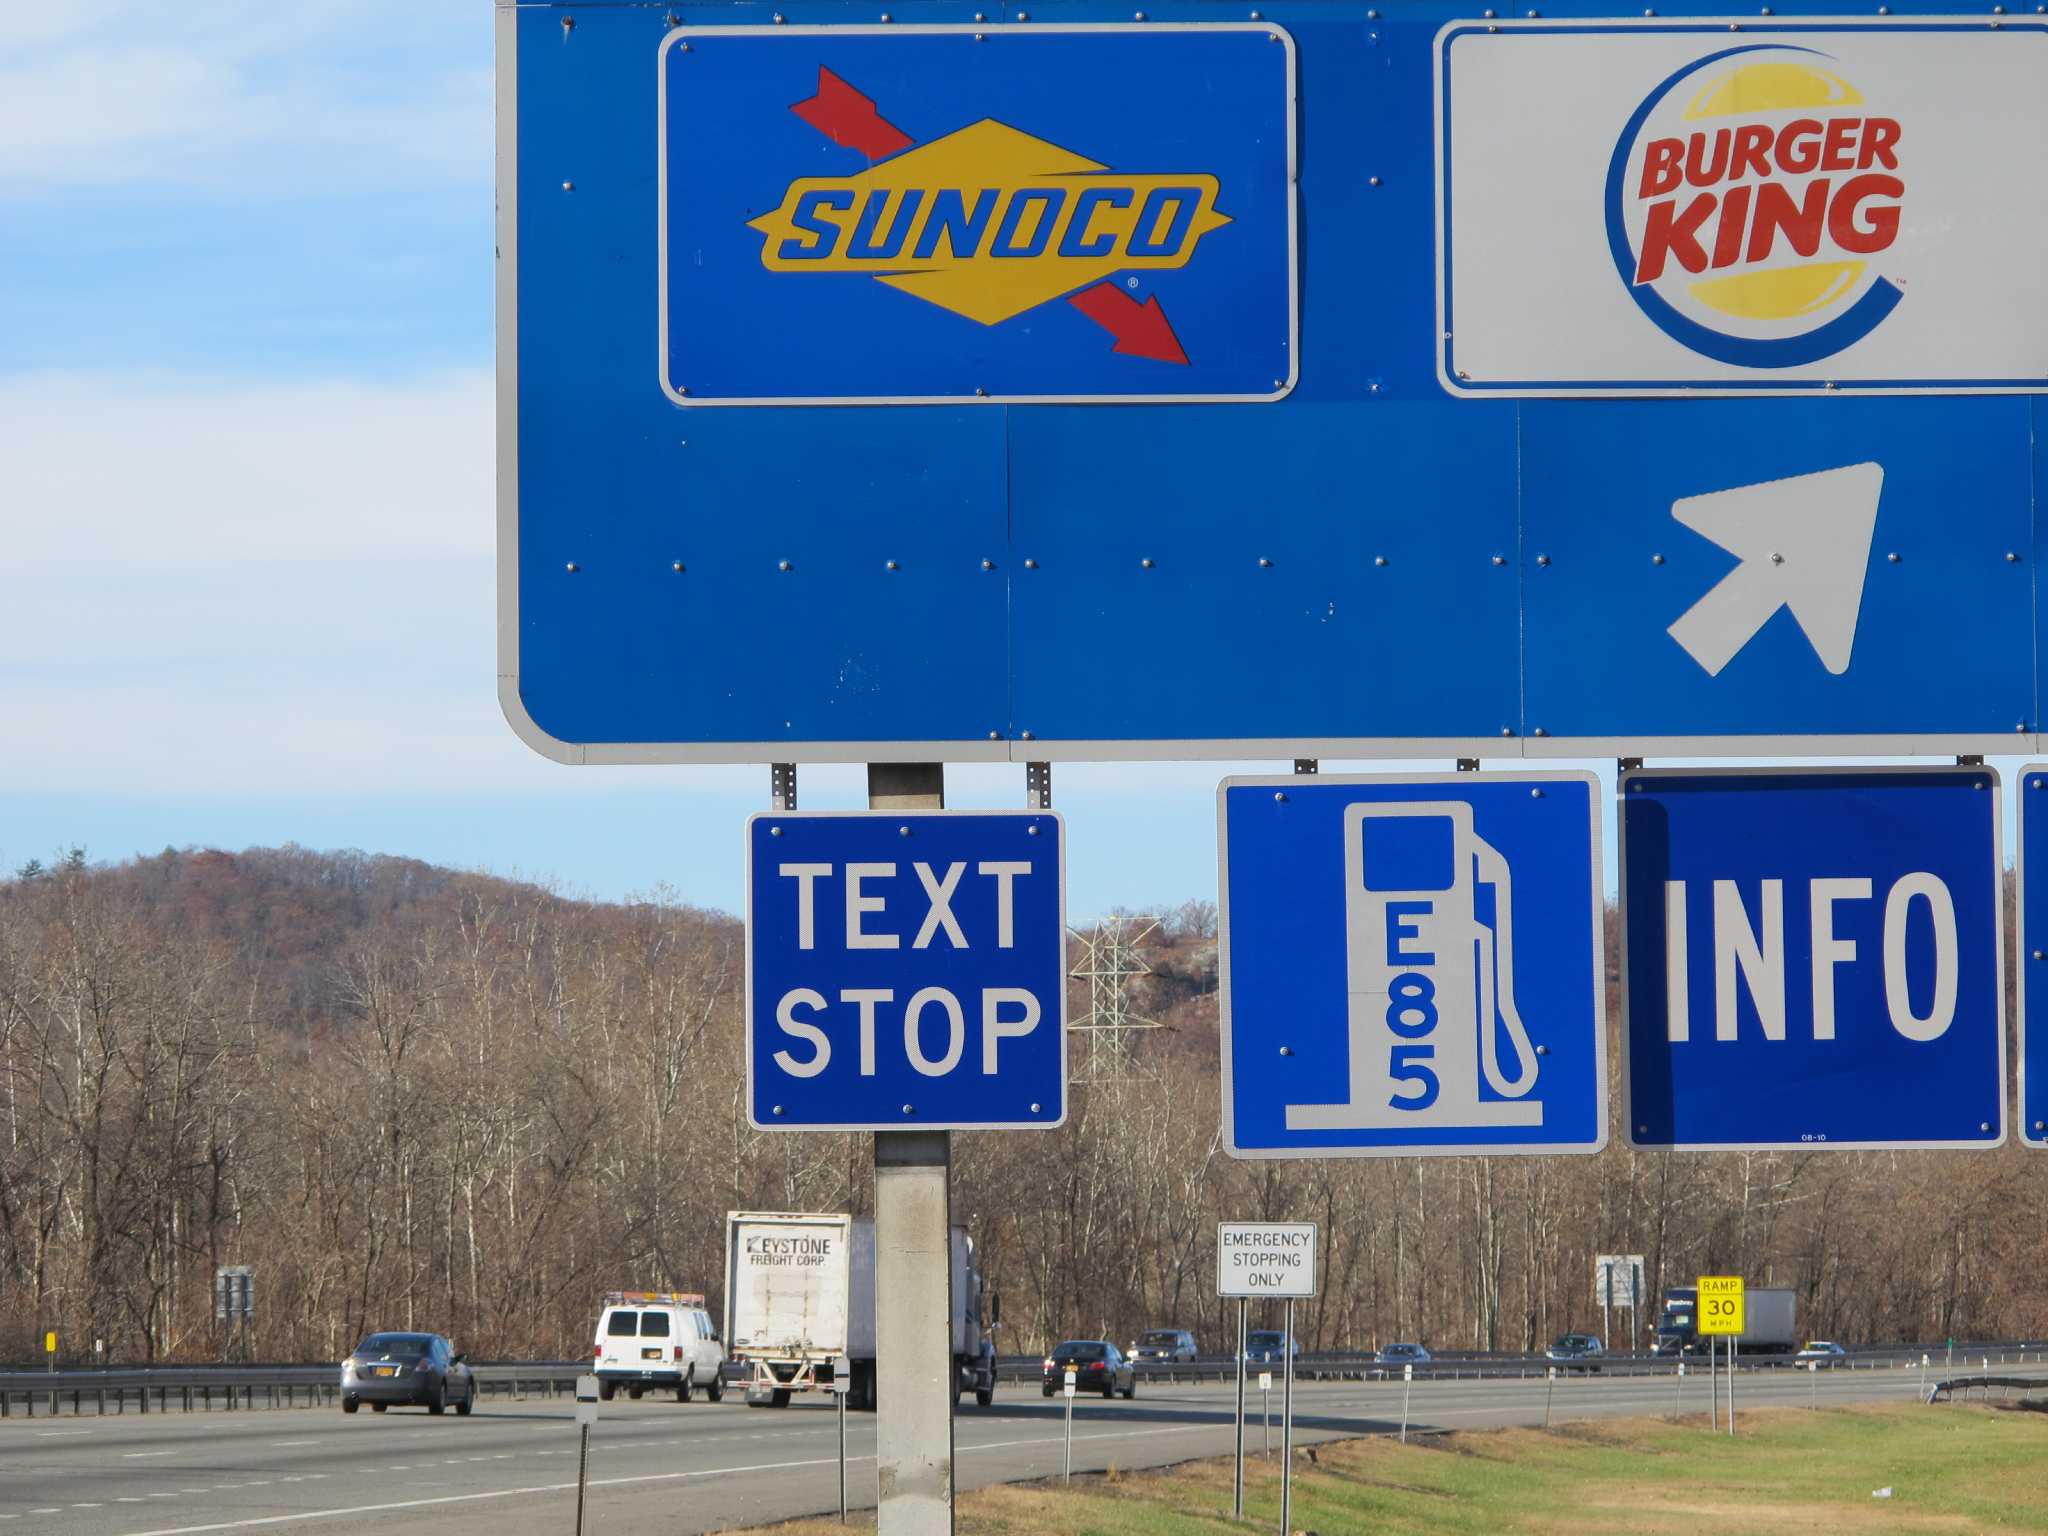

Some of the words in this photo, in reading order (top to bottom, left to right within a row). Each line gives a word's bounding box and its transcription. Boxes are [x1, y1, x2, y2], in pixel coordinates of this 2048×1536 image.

[1638, 117, 1902, 200] BURGER
[777, 187, 1203, 260] SUNOCO
[1636, 173, 1906, 284] KING
[779, 861, 1033, 950] TEXT
[1664, 871, 1959, 1042] INFO
[772, 986, 1042, 1078] STOP
[746, 1235, 831, 1254] KEYSTONE
[1223, 1233, 1310, 1246] EMERGENCY
[750, 1254, 793, 1266] FREIGHT
[1233, 1253, 1301, 1267] STOPPING
[1248, 1272, 1285, 1287] ONLY
[1703, 1281, 1737, 1291] RAMP
[1707, 1300, 1735, 1315] 30
